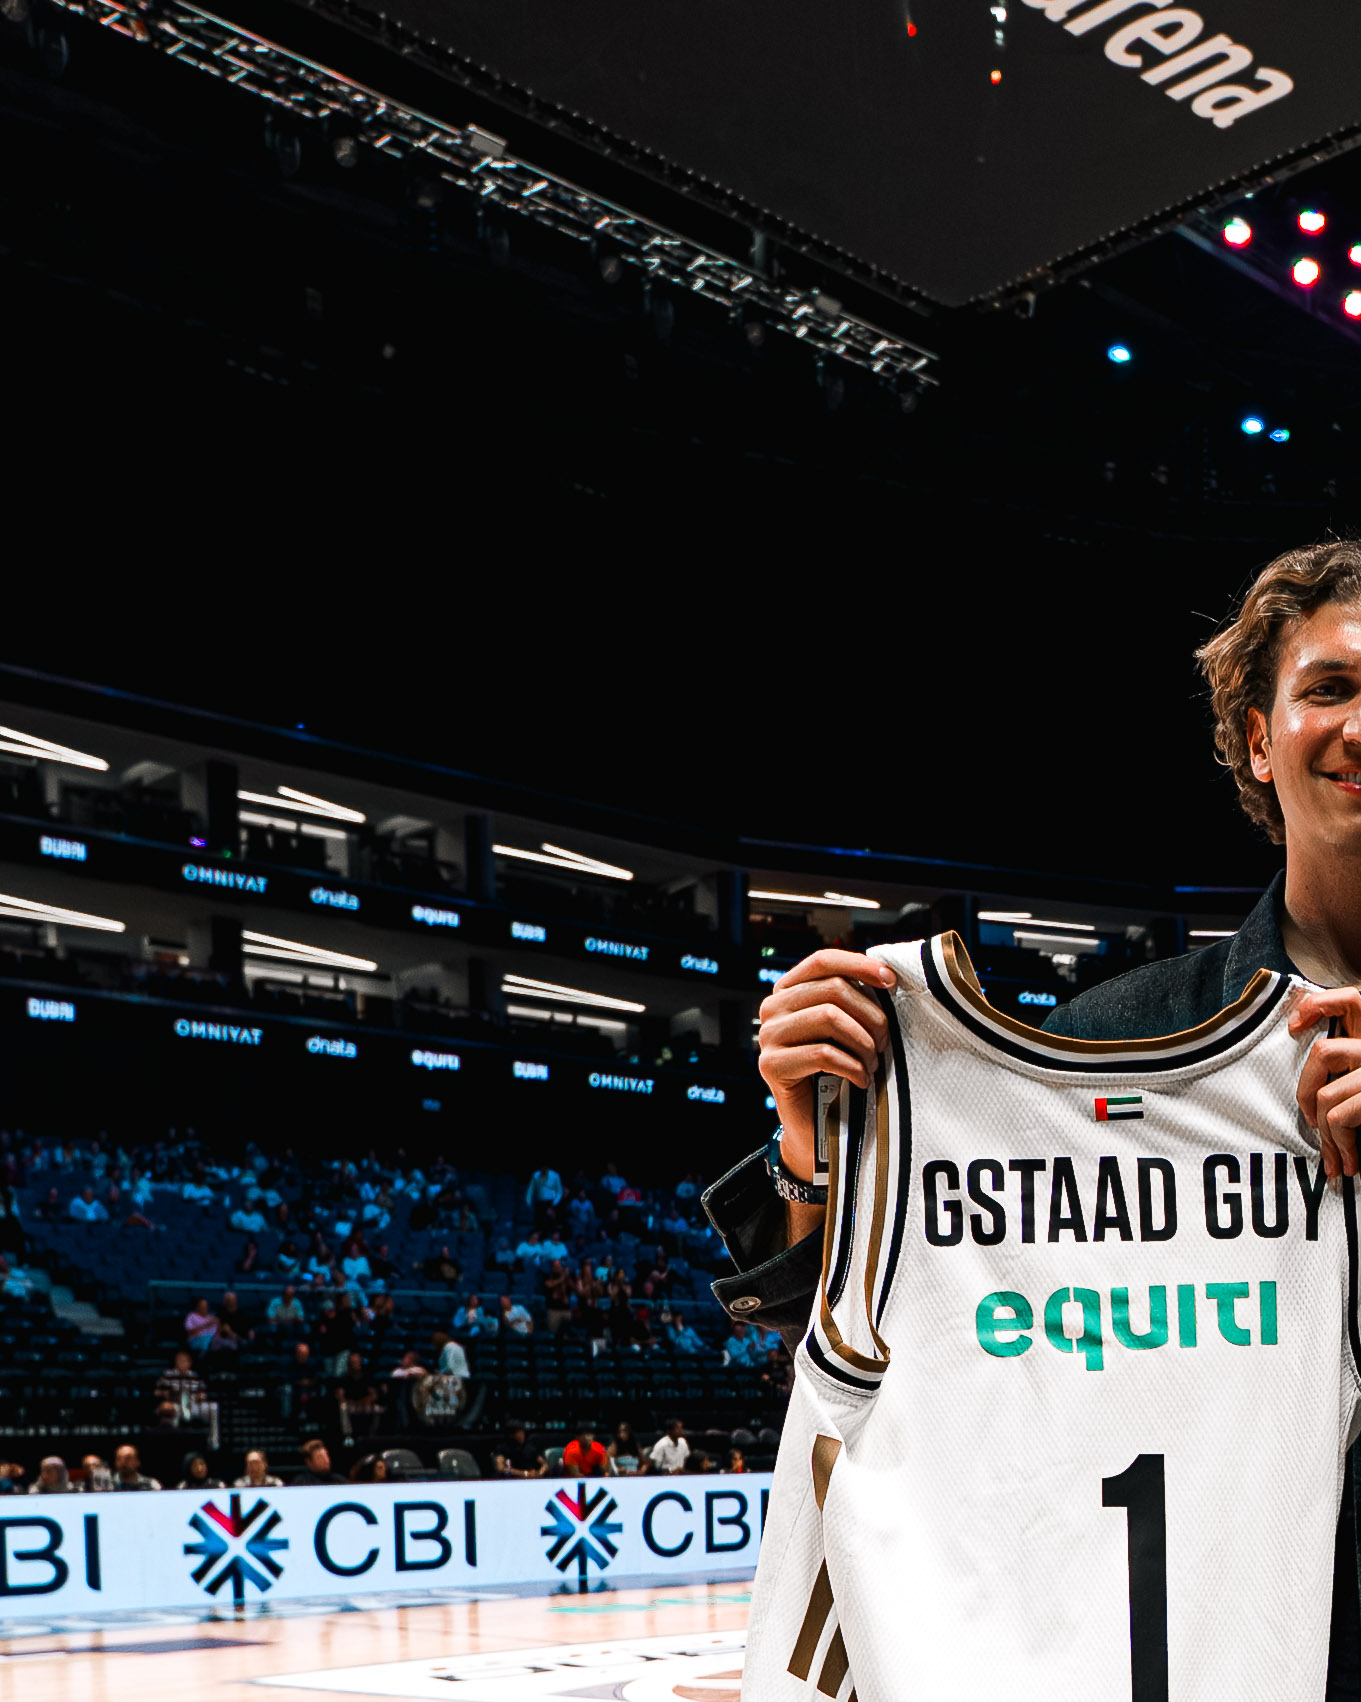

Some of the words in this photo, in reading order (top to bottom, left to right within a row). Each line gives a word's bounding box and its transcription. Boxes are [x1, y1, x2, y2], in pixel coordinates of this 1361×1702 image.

[183, 864, 267, 893] OMNIYAT
[585, 937, 649, 961] OMNIYAT
[175, 1019, 262, 1045] OMNIYAT
[307, 1036, 357, 1058] dnata
[589, 1073, 654, 1094] OMNIYAT
[922, 1156, 1178, 1247] GSTAAD
[1202, 1152, 1329, 1243] GUY
[975, 1281, 1278, 1371] equiti
[313, 1498, 477, 1577] CBI
